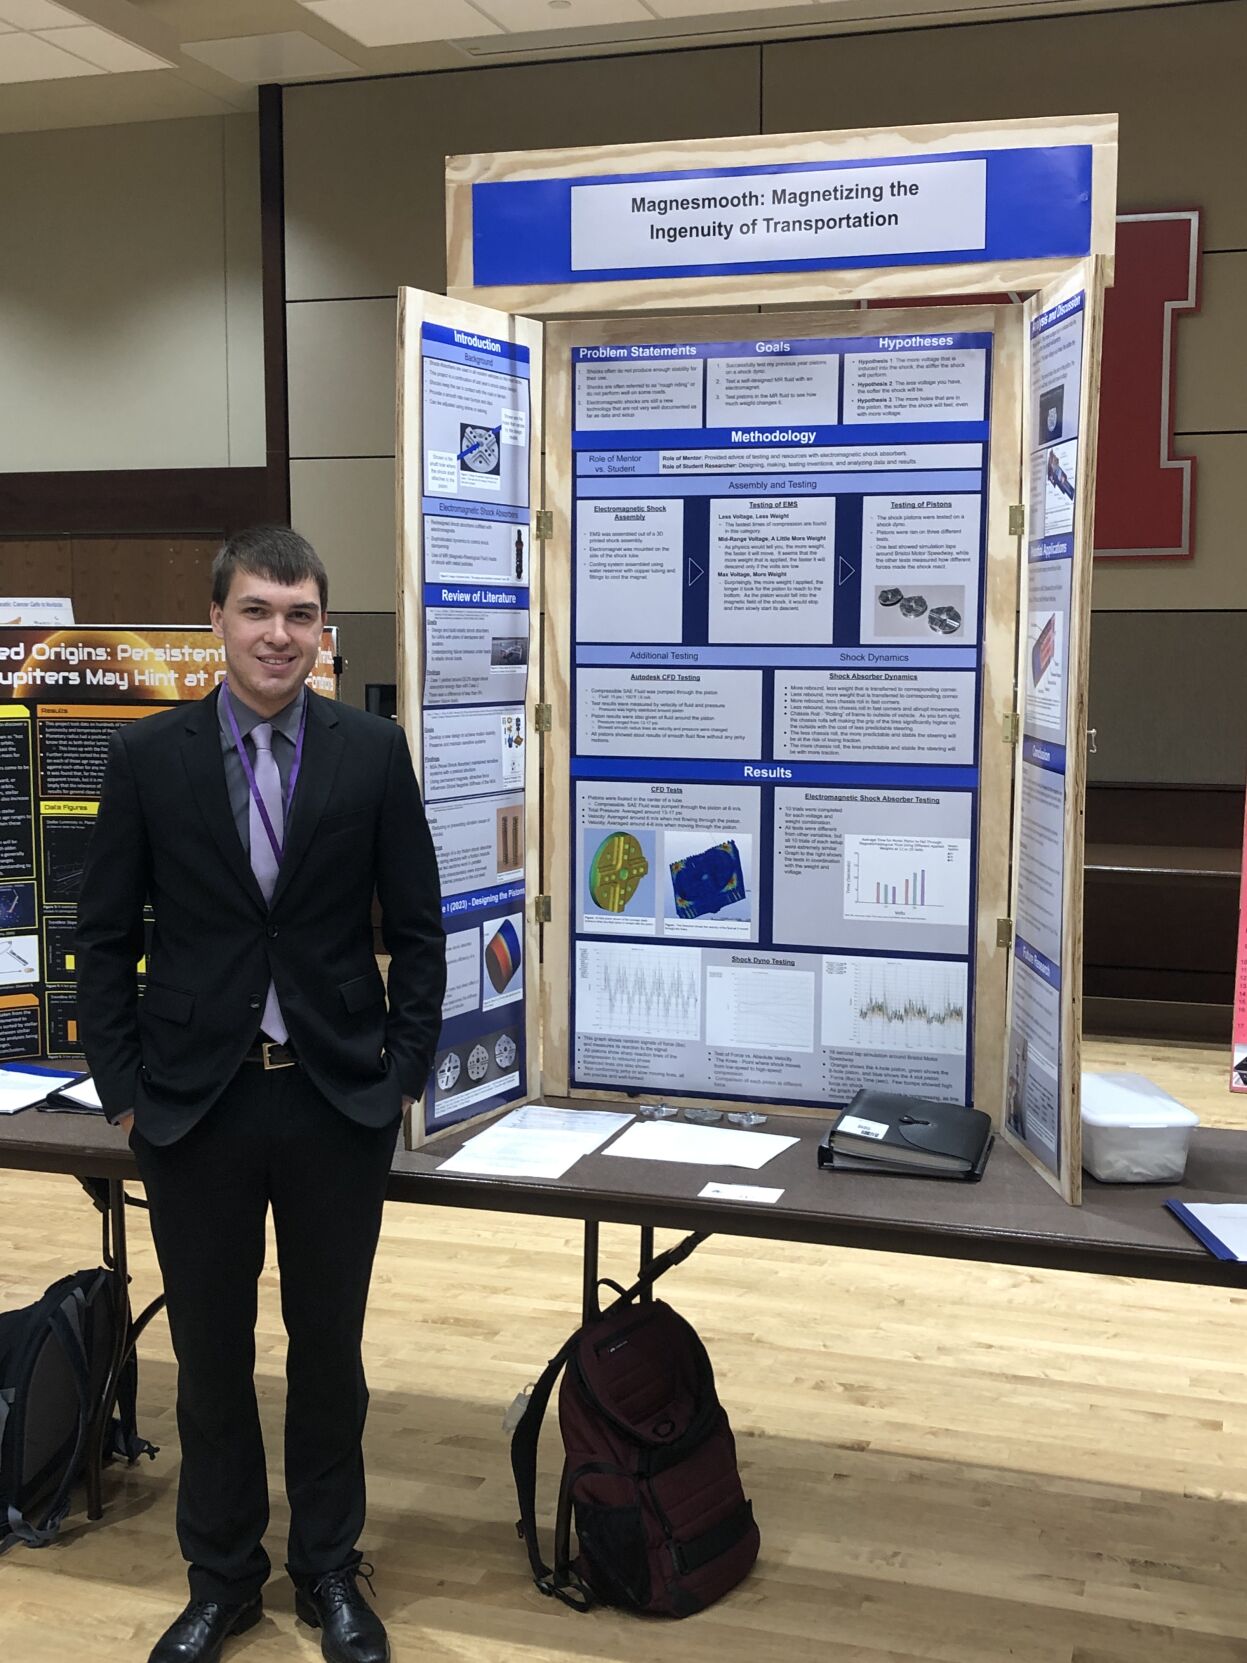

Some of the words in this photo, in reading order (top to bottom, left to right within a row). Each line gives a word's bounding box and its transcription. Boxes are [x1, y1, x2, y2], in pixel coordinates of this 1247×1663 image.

[631, 190, 765, 215] Magnesmooth:
[772, 185, 884, 207] Magnetizing
[889, 181, 919, 197] the
[650, 221, 734, 243] Ingenuity
[739, 219, 758, 235] of
[763, 211, 899, 233] Transportation
[454, 330, 501, 352] Introduction
[879, 336, 953, 350] Hypotheses
[579, 347, 627, 359] Problem
[630, 346, 697, 358] Statements
[756, 342, 790, 353] Goals
[464, 352, 493, 367] Background
[731, 430, 816, 443] Methodology
[589, 455, 606, 463] Role
[607, 455, 615, 463] of
[607, 465, 635, 473] Student
[788, 480, 817, 488] Testing
[646, 505, 667, 513] Shock
[749, 501, 773, 509] Testing
[774, 501, 781, 509] of
[782, 501, 798, 509] EMS
[917, 501, 925, 509] of
[439, 503, 479, 519] Electromagnetic
[480, 506, 495, 516] Shock
[442, 589, 470, 602] Review
[472, 591, 480, 602] of
[482, 591, 516, 604] Literature
[32, 643, 111, 665] Origins:
[117, 644, 226, 662] Persistent
[630, 651, 669, 660] Additional
[670, 652, 699, 660] Testing
[840, 653, 866, 662] Shock
[867, 653, 909, 662] Dynamics
[86, 669, 129, 691] May
[134, 669, 180, 687] Hint
[184, 670, 208, 687] at
[661, 673, 676, 681] CFD
[677, 674, 700, 682] Testing
[744, 766, 793, 778] Results
[651, 786, 665, 794] CFD
[666, 786, 683, 794] Tests
[805, 794, 858, 802] Electromagnetic
[859, 795, 881, 803] Shock
[882, 796, 914, 804] Absorber
[915, 797, 940, 805] Testing
[63, 804, 88, 812] Figures
[450, 899, 467, 913] (2023)
[472, 894, 499, 907] Designing
[499, 891, 507, 900] the
[731, 956, 752, 964] Shock
[753, 957, 771, 965] Dyno
[771, 958, 795, 967] Testing
